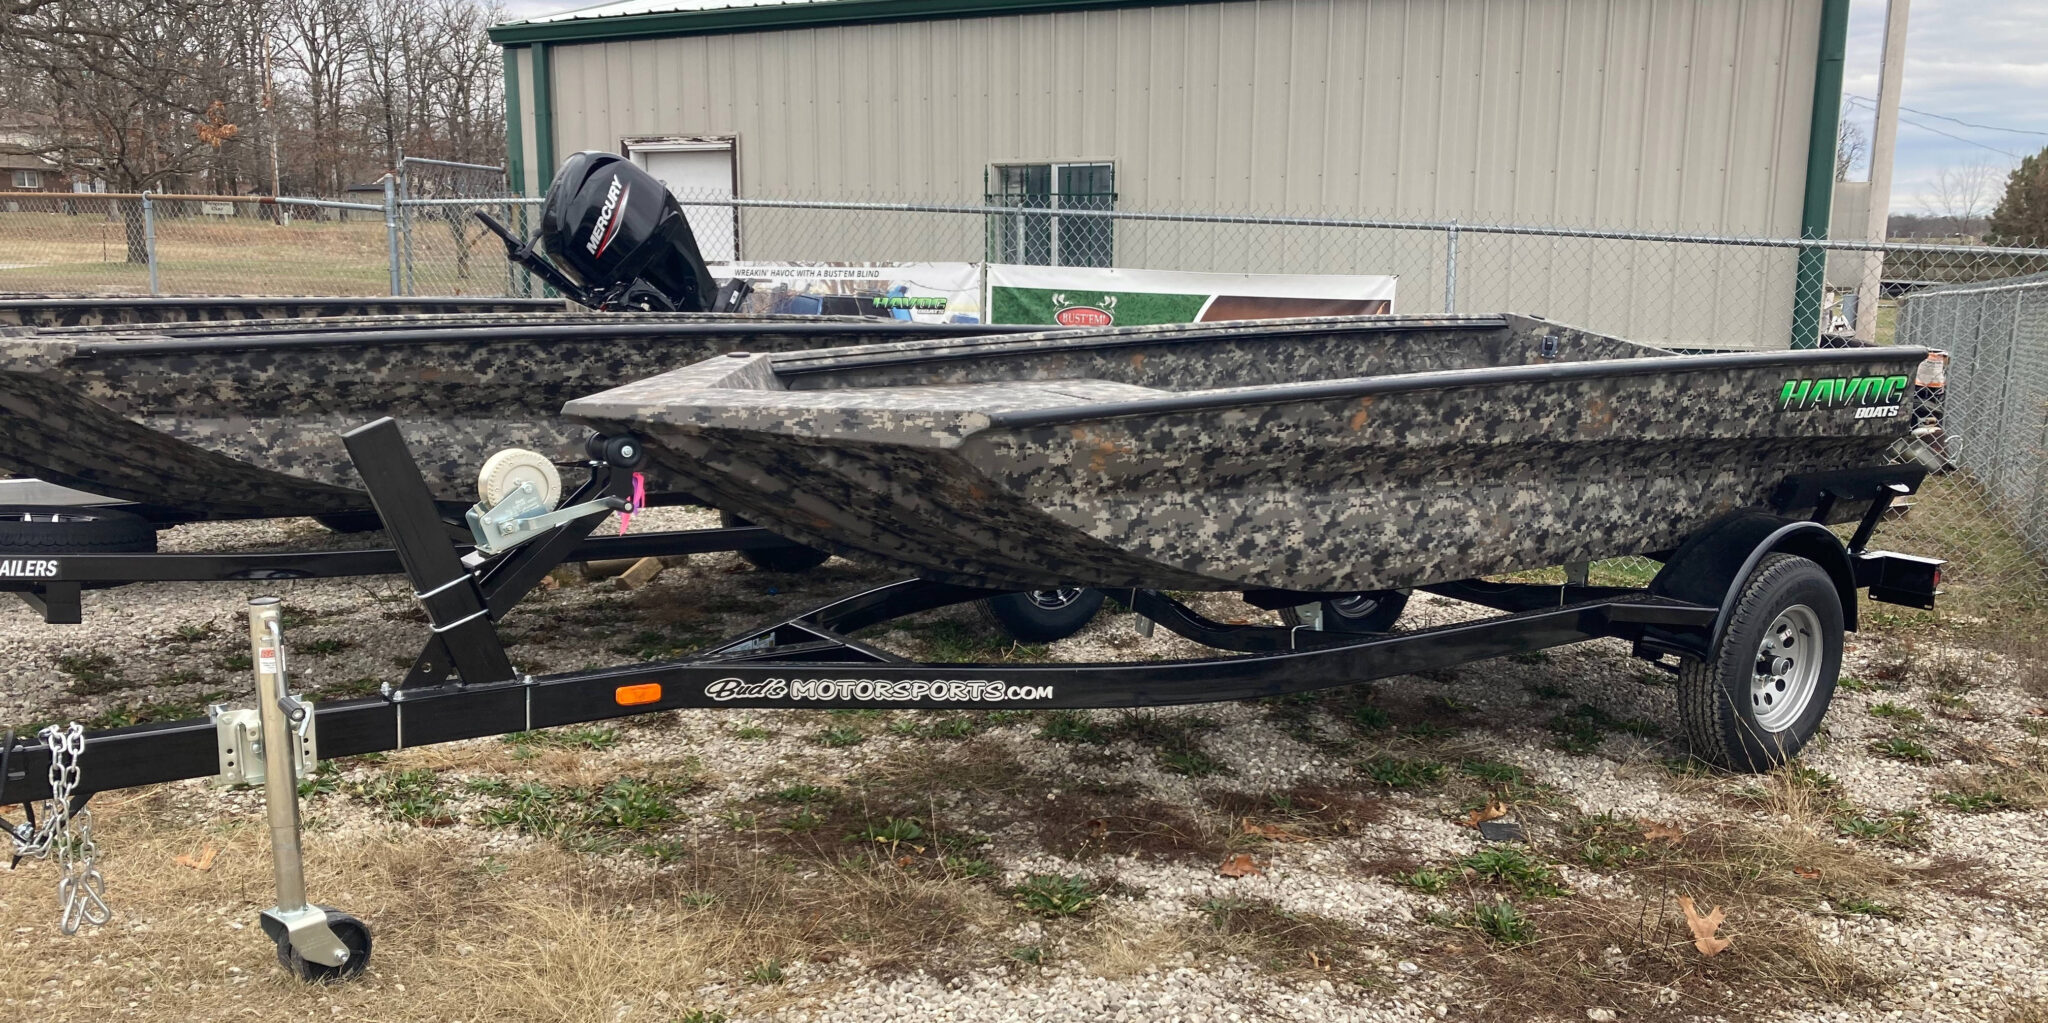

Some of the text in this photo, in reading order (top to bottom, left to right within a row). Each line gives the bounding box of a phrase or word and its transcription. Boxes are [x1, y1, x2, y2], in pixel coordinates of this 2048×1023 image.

[586, 173, 623, 255] MERCURY
[734, 269, 880, 278] WREAKIN' HAVOC WITH A BUST'EM BLIND
[873, 297, 948, 309] HAVOC
[1062, 313, 1106, 325] BUST'EM!
[1776, 375, 1908, 412] HAVOC
[1854, 405, 1900, 419] BOATS
[0, 560, 58, 577] AILERS
[704, 677, 788, 701] Bud's
